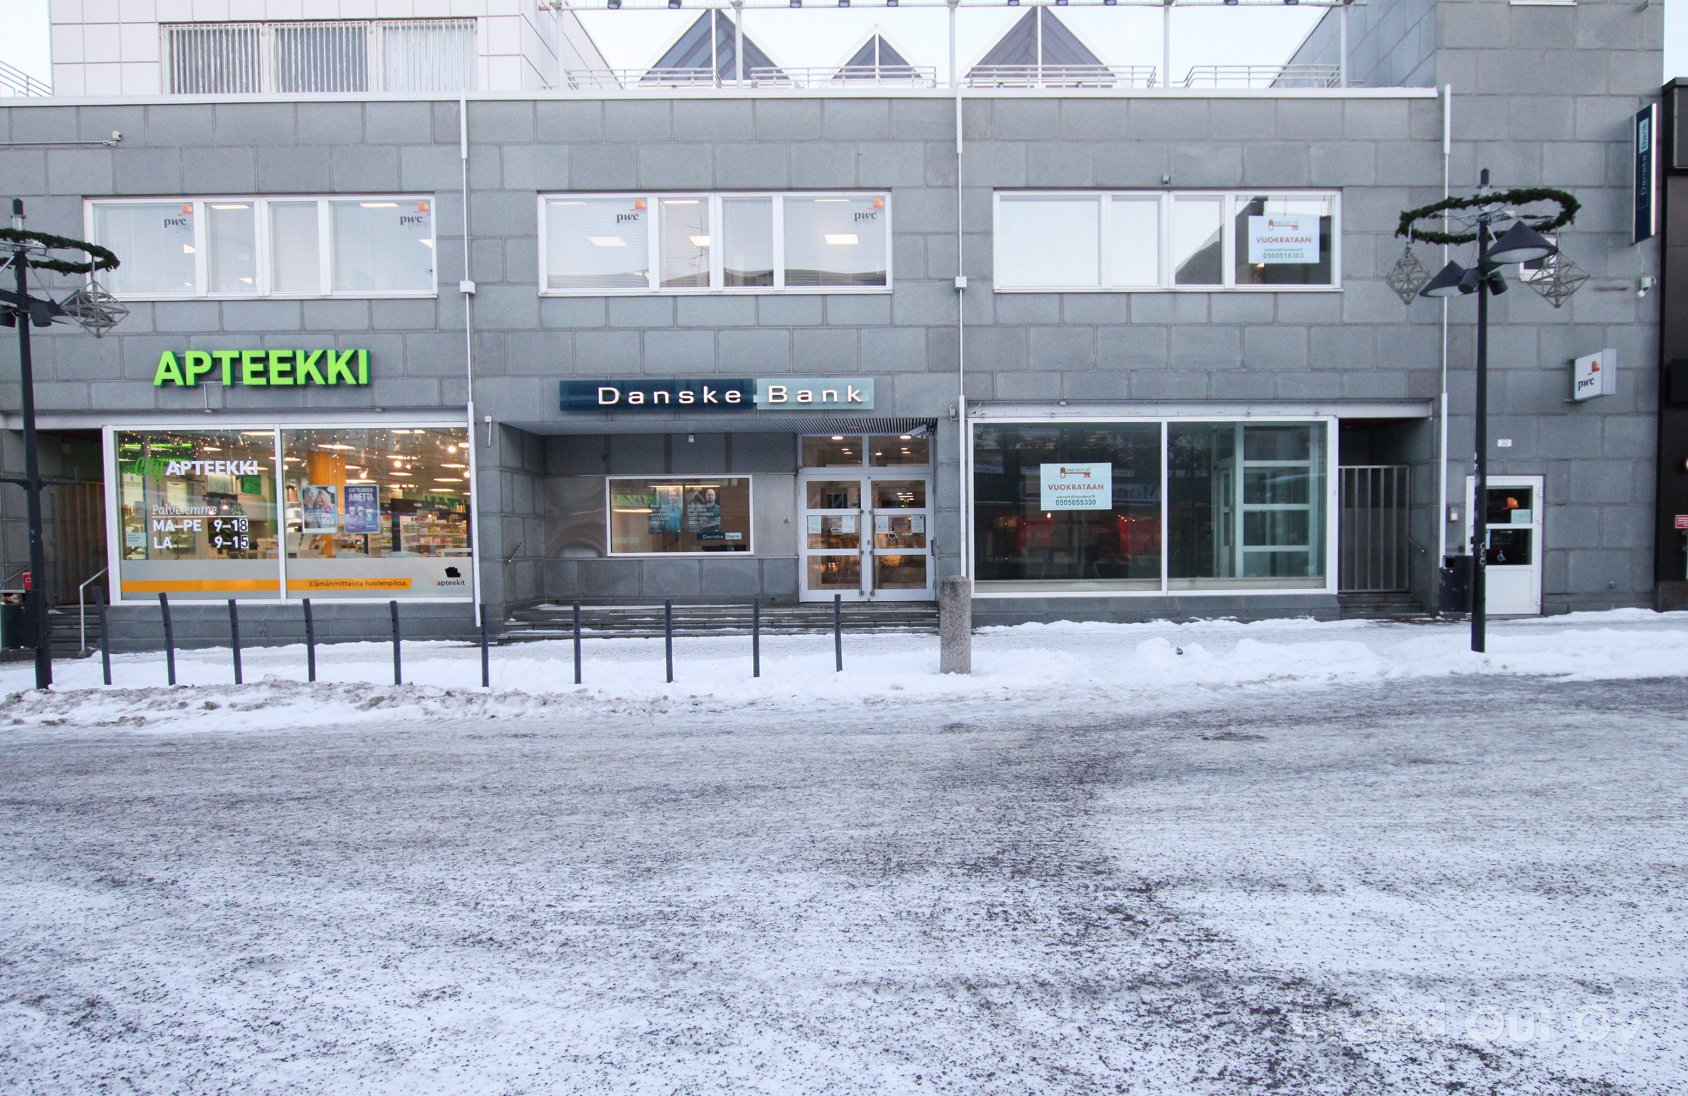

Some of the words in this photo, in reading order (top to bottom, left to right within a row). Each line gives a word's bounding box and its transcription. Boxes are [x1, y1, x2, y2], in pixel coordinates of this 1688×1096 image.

[163, 216, 187, 228] pwc
[399, 213, 424, 225] pwc
[615, 212, 640, 224] pwc
[853, 211, 878, 223] pwc
[153, 349, 372, 387] APTEEKKI
[1577, 377, 1595, 391] pwc
[597, 385, 742, 405] Danske
[767, 384, 863, 403] Bank
[165, 460, 258, 475] APTEEKKI
[152, 504, 218, 515] Palvelemme
[153, 537, 173, 549] LA
